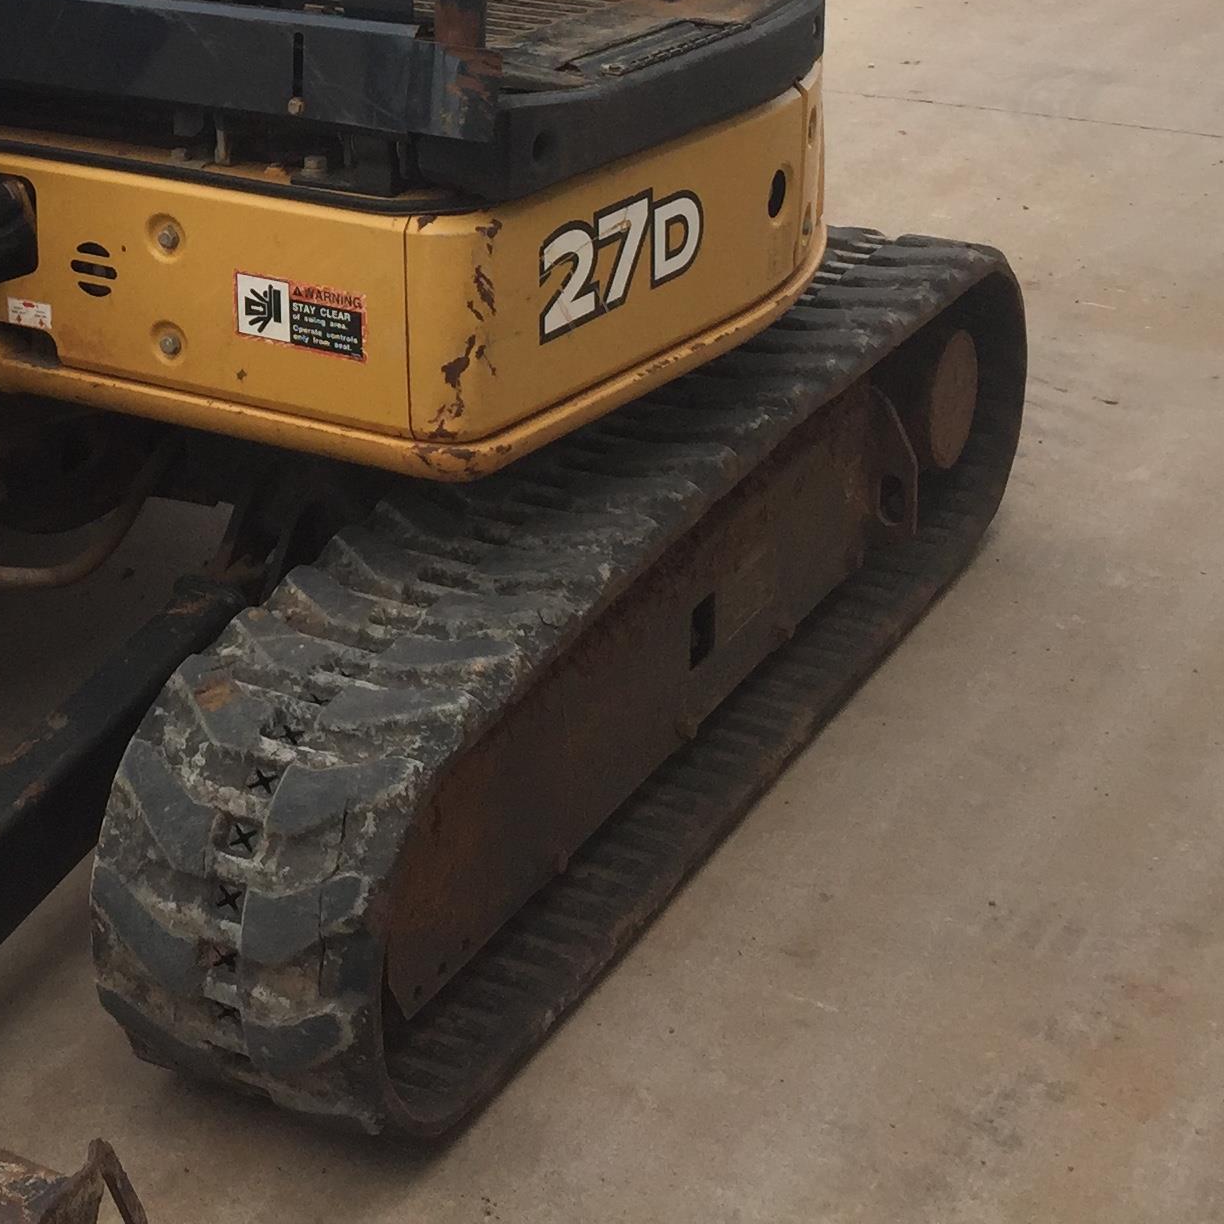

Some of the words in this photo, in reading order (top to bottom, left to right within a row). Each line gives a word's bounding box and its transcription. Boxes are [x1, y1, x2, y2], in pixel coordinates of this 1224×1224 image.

[539, 187, 704, 346] 27D
[305, 287, 362, 308] WARNING
[292, 302, 316, 314] STAY
[320, 308, 351, 321] CLEAR
[292, 325, 322, 336] Operate
